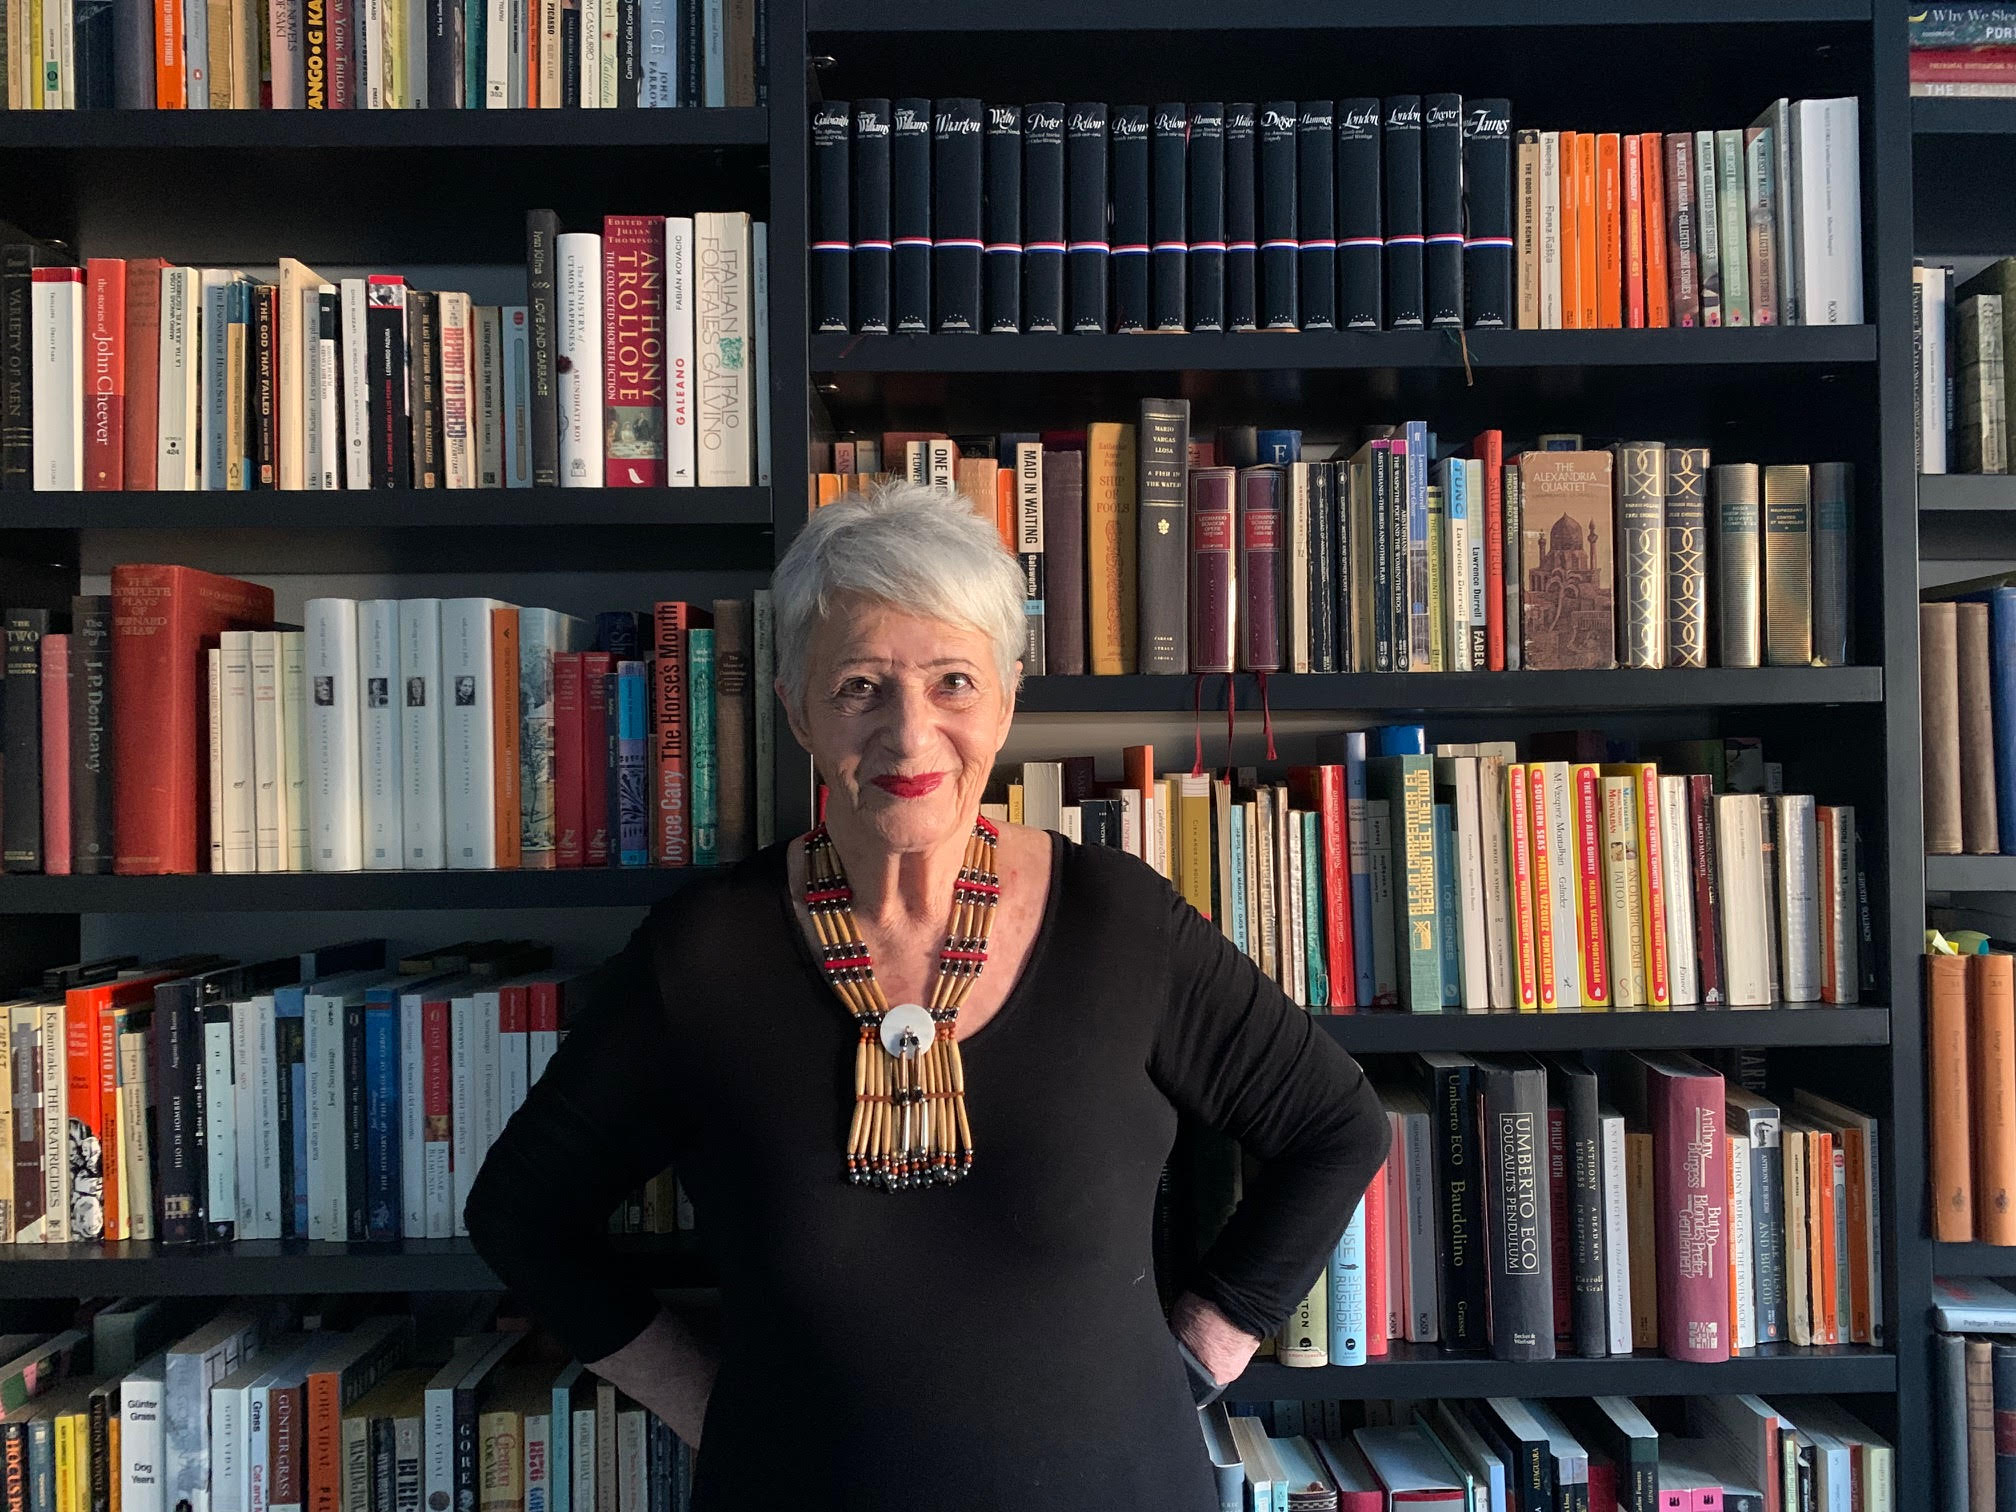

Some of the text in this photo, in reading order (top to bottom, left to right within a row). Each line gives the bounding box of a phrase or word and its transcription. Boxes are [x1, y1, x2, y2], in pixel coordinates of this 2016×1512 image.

[276, 11, 286, 38] SAKI
[287, 13, 298, 51] NOVELS
[546, 3, 555, 35] PICASSO
[585, 11, 595, 61] CASMURRO
[650, 18, 665, 55] ICE
[1933, 10, 1963, 21] Why
[1968, 9, 1989, 21] We
[335, 19, 347, 105] YORK TRILOGY
[602, 54, 615, 103] Malinche
[659, 71, 668, 101] JOHN
[935, 113, 981, 135] Wharton
[989, 109, 1016, 128] Welty
[1026, 113, 1064, 131] Porter
[1068, 114, 1105, 131] Bellow
[1112, 116, 1149, 134] Bellow
[1339, 107, 1379, 129] London
[1387, 106, 1421, 127] London
[675, 236, 683, 275] KOVACIC
[261, 325, 269, 347] GOD
[535, 298, 547, 396] LOVE AND GARBAGE
[568, 300, 576, 352] HAPPINESS
[607, 252, 616, 400] THE COLLECTED SHORTER FICTION
[618, 251, 639, 401] TROLLOPE
[641, 251, 661, 401] ANTHONY
[10, 289, 21, 417] VARIETY OF MEN
[92, 279, 114, 445] the stories of John Cheever
[215, 287, 224, 415] THE ENGINEER HUMAN SOULS
[262, 380, 270, 415] FAILED
[444, 327, 467, 438] REPORT TO GRECO
[676, 358, 685, 425] GALEANO
[702, 353, 721, 451] CALVINO
[484, 410, 492, 418] LA
[934, 449, 947, 471] ONE
[1534, 473, 1597, 482] ALEXANDRIA
[1555, 463, 1574, 472] THE
[1096, 503, 1130, 513] FOOLS
[1454, 465, 1464, 515] TUNC
[1541, 482, 1586, 492] QUARTET
[1023, 450, 1039, 597] MAID IN WAITING Galsworthy
[1472, 547, 1485, 666] Lawrence Durrell FABER
[7, 631, 40, 642] TWO
[659, 605, 682, 762] The Horse's Mouth
[84, 691, 103, 773] Donleavy
[661, 771, 685, 861] Joyce Cary
[1535, 784, 1544, 826] SOUTHERN
[1536, 830, 1545, 850] SEAS
[1584, 796, 1595, 875] BUENOS AIRES QUINTET
[1649, 830, 1657, 855] CENTRAL
[1697, 815, 1706, 877] ALBERTO MANGUEL
[1538, 856, 1548, 891] MANUEL
[1443, 885, 1454, 960] LOS CISNES
[1539, 894, 1551, 931] VÁZQUEZ
[1632, 935, 1642, 969] DEATH
[102, 1025, 113, 1093] OCTAVIO PAZ
[46, 1012, 60, 1208] Kazantzakis THE FRATRICIDES
[1700, 1107, 1716, 1159] Anthony
[1551, 1121, 1564, 1178] PHILIP ROTH
[1576, 1141, 1585, 1188] BURGESS
[1586, 1139, 1596, 1191] ANTHONY
[1684, 1142, 1700, 1188] Burgess
[1448, 1074, 1468, 1337] Umberto ECO Baudolino Grasset
[1503, 1118, 1519, 1269] FOUCAULT'S PENDULUM
[1516, 1118, 1537, 1269] UMBERTO ECO
[1693, 1194, 1707, 1240] Blondes
[1706, 1207, 1721, 1246] But Do
[1679, 1209, 1693, 1278] Gentlemen?
[1759, 1222, 1772, 1305] AND BIG GOD
[1335, 1275, 1347, 1333] RUSHDIE
[128, 1399, 158, 1409] Günter
[130, 1413, 156, 1421] Grass
[134, 1463, 152, 1473] Dog
[253, 1401, 263, 1504] Grass Cat and
[278, 1395, 291, 1497] GÜNTER GRASS
[131, 1476, 155, 1485] Years
